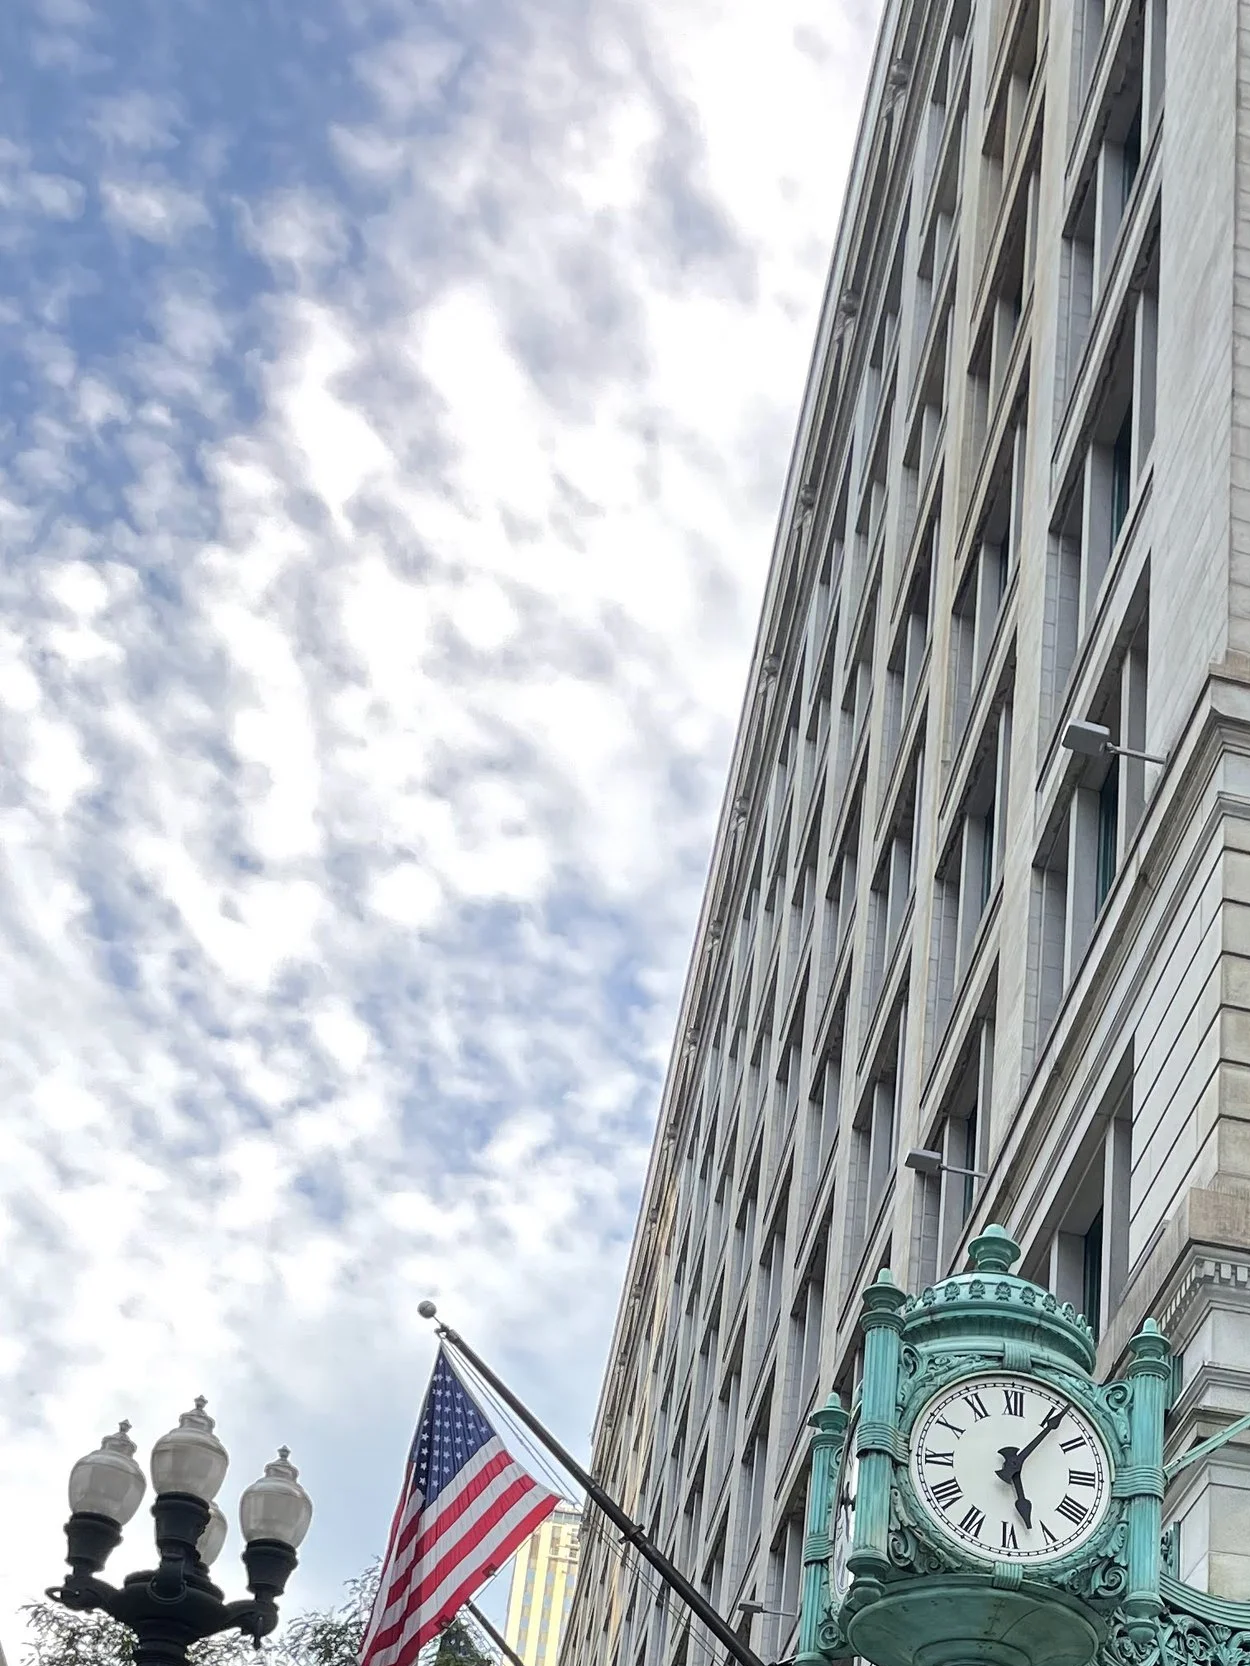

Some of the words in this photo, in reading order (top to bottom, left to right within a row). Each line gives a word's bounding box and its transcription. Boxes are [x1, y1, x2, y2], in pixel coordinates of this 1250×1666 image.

[962, 1392, 991, 1423] XI
[1002, 1389, 1026, 1418] XII
[935, 1413, 966, 1440] X
[925, 1449, 954, 1468] IX
[1059, 1435, 1087, 1454] II
[1068, 1468, 1096, 1489] III
[930, 1476, 964, 1511] VIII
[958, 1504, 986, 1539] VII
[1001, 1520, 1019, 1549] VI
[1039, 1520, 1059, 1546] V
